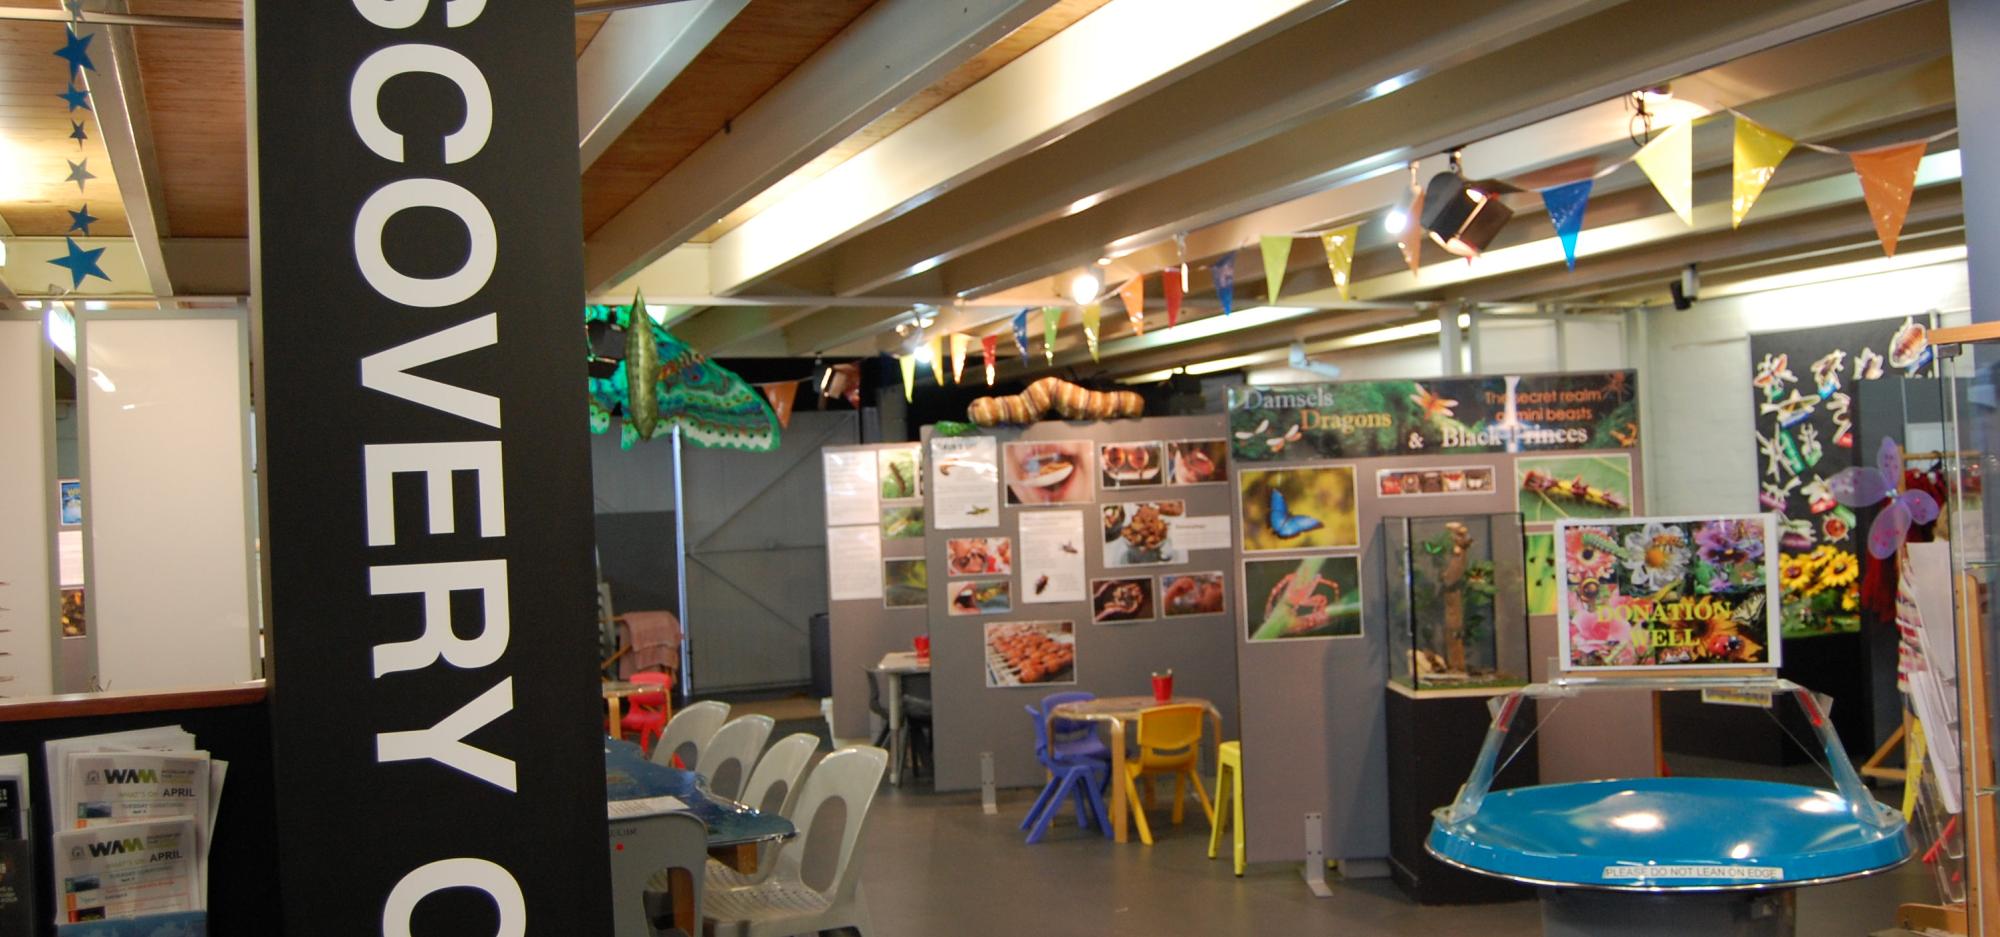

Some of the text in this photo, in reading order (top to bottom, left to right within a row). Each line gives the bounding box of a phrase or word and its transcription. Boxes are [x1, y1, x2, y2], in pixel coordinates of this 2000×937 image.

[349, 0, 518, 793] COVERY
[1243, 387, 1334, 409] Damsels
[1560, 388, 1602, 402] realm
[1300, 409, 1392, 434] Dragons
[1547, 406, 1593, 421] beasts
[1408, 432, 1424, 449] &
[1441, 425, 1502, 447] Black
[1597, 601, 1731, 621] DONATION
[1630, 627, 1700, 648] WELL
[104, 768, 159, 784] WAM
[163, 787, 196, 798] APRIL
[88, 837, 144, 858] WAM
[150, 850, 183, 863] APRIL
[1606, 867, 1777, 878] PLEASE DO NOT LEAN ON EDGE
